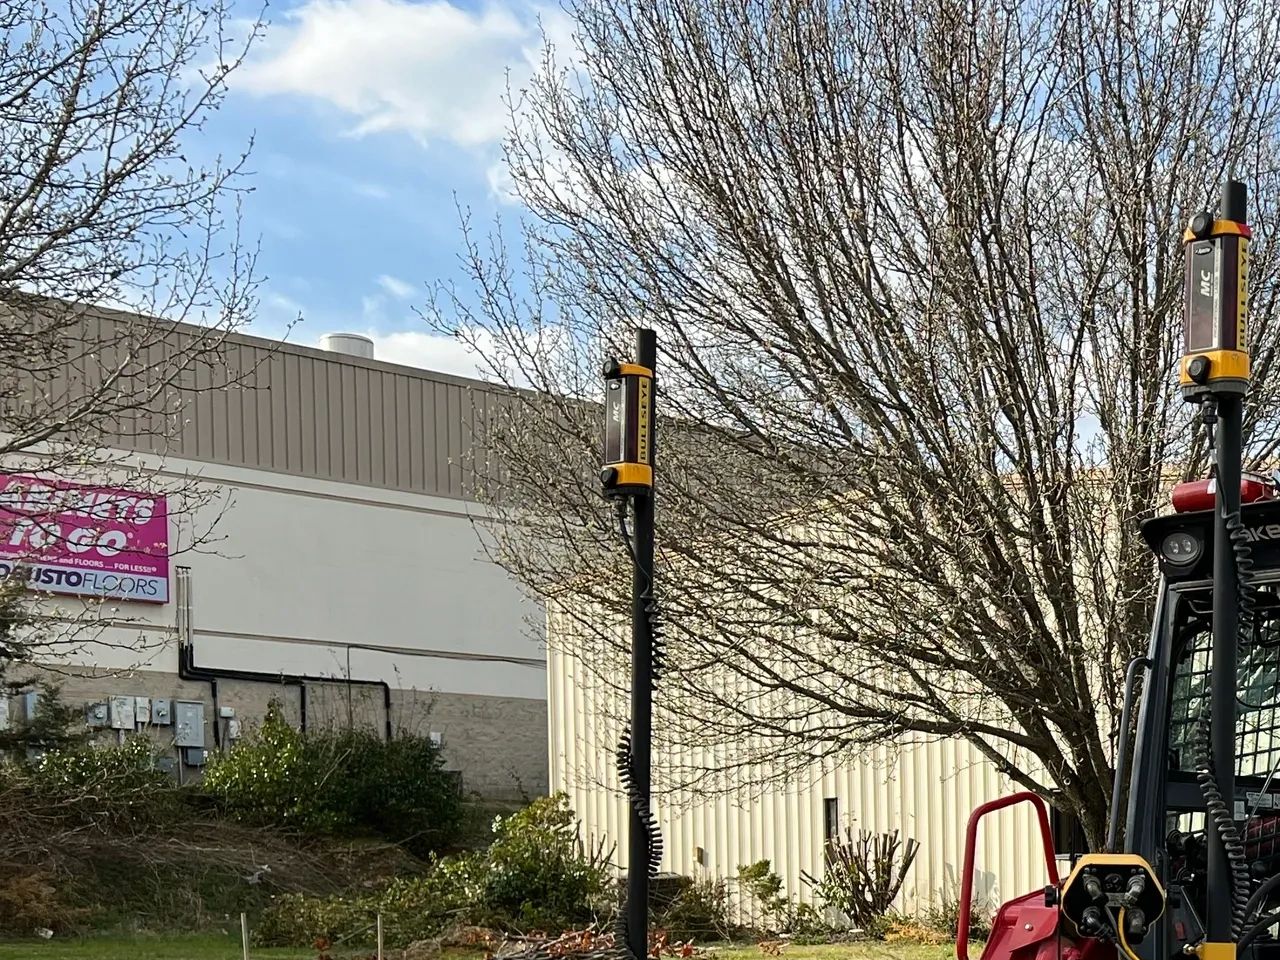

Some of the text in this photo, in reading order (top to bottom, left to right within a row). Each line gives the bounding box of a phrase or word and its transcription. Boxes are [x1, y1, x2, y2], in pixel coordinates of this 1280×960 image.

[1201, 270, 1210, 297] MC
[613, 402, 619, 421] MC
[9, 515, 62, 550] TO
[75, 559, 104, 568] FLOORS
[114, 563, 130, 571] FOR
